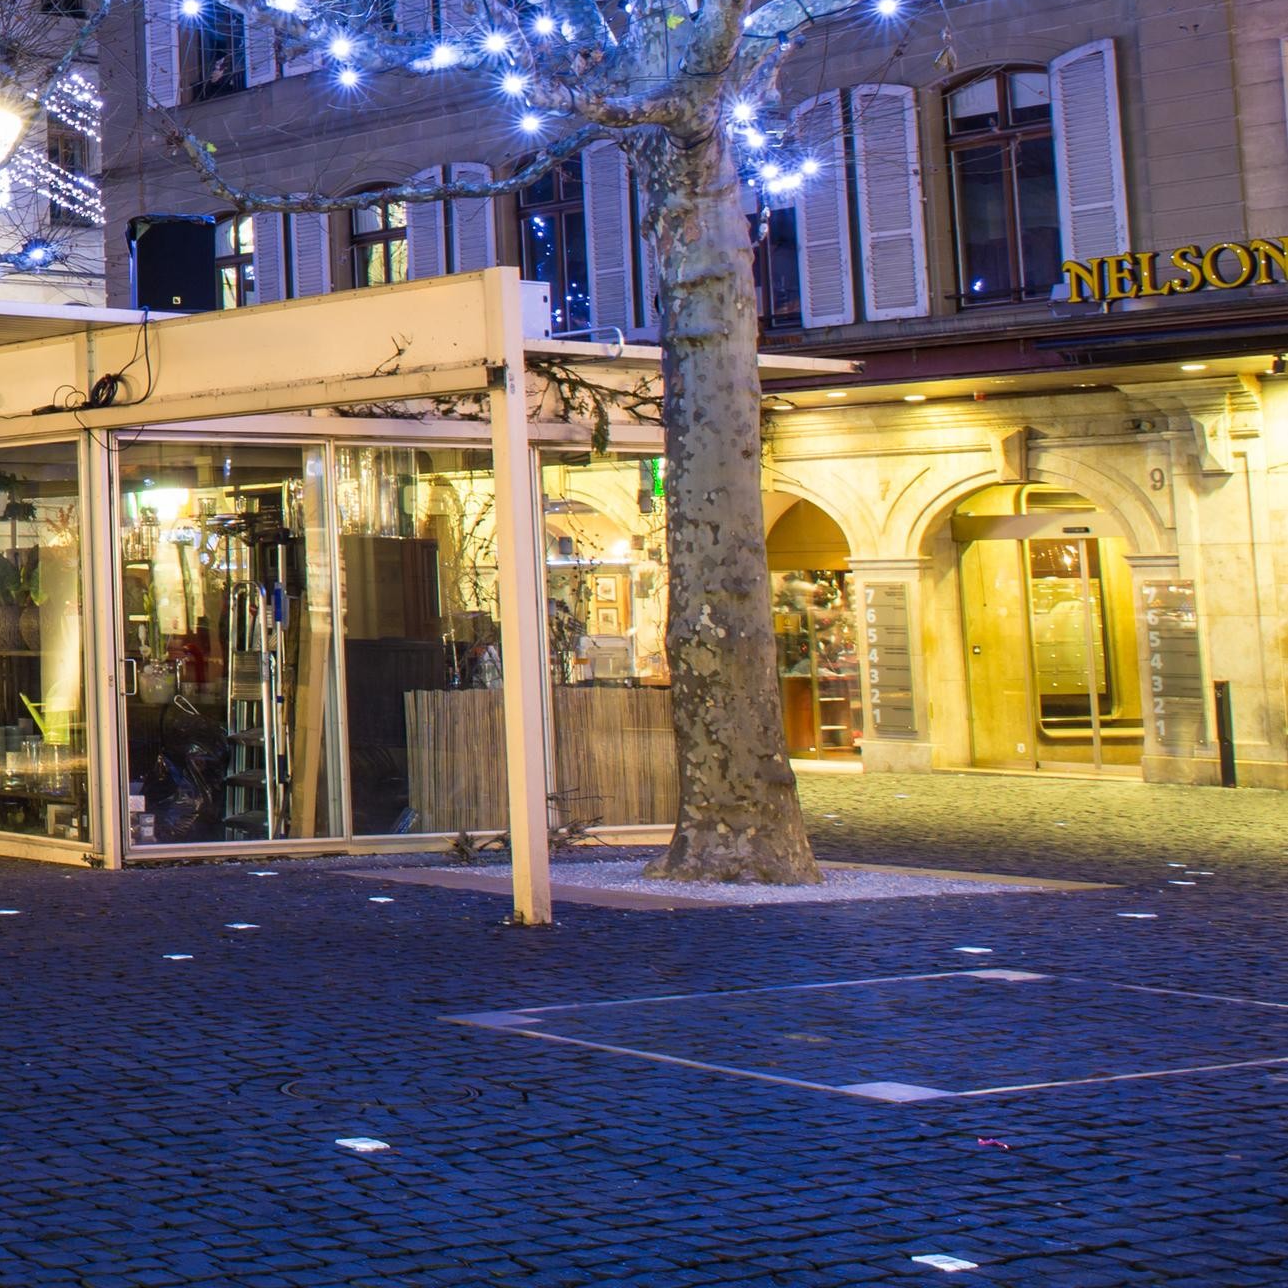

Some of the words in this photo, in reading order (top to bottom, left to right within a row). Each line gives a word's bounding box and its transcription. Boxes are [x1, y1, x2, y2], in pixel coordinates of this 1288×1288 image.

[1062, 236, 1288, 303] NELSON
[1150, 467, 1165, 491] 9
[865, 589, 875, 604] 7
[866, 609, 876, 623] 6
[1147, 609, 1159, 625] 6
[868, 629, 878, 643] 5
[1149, 631, 1161, 647] 5
[869, 649, 879, 663] 4
[1151, 653, 1163, 669] 4
[870, 669, 879, 683] 3
[1152, 676, 1163, 692] 3
[871, 689, 881, 703] 2
[1153, 698, 1165, 713] 2
[873, 709, 881, 723] 1
[1156, 720, 1166, 735] 1
